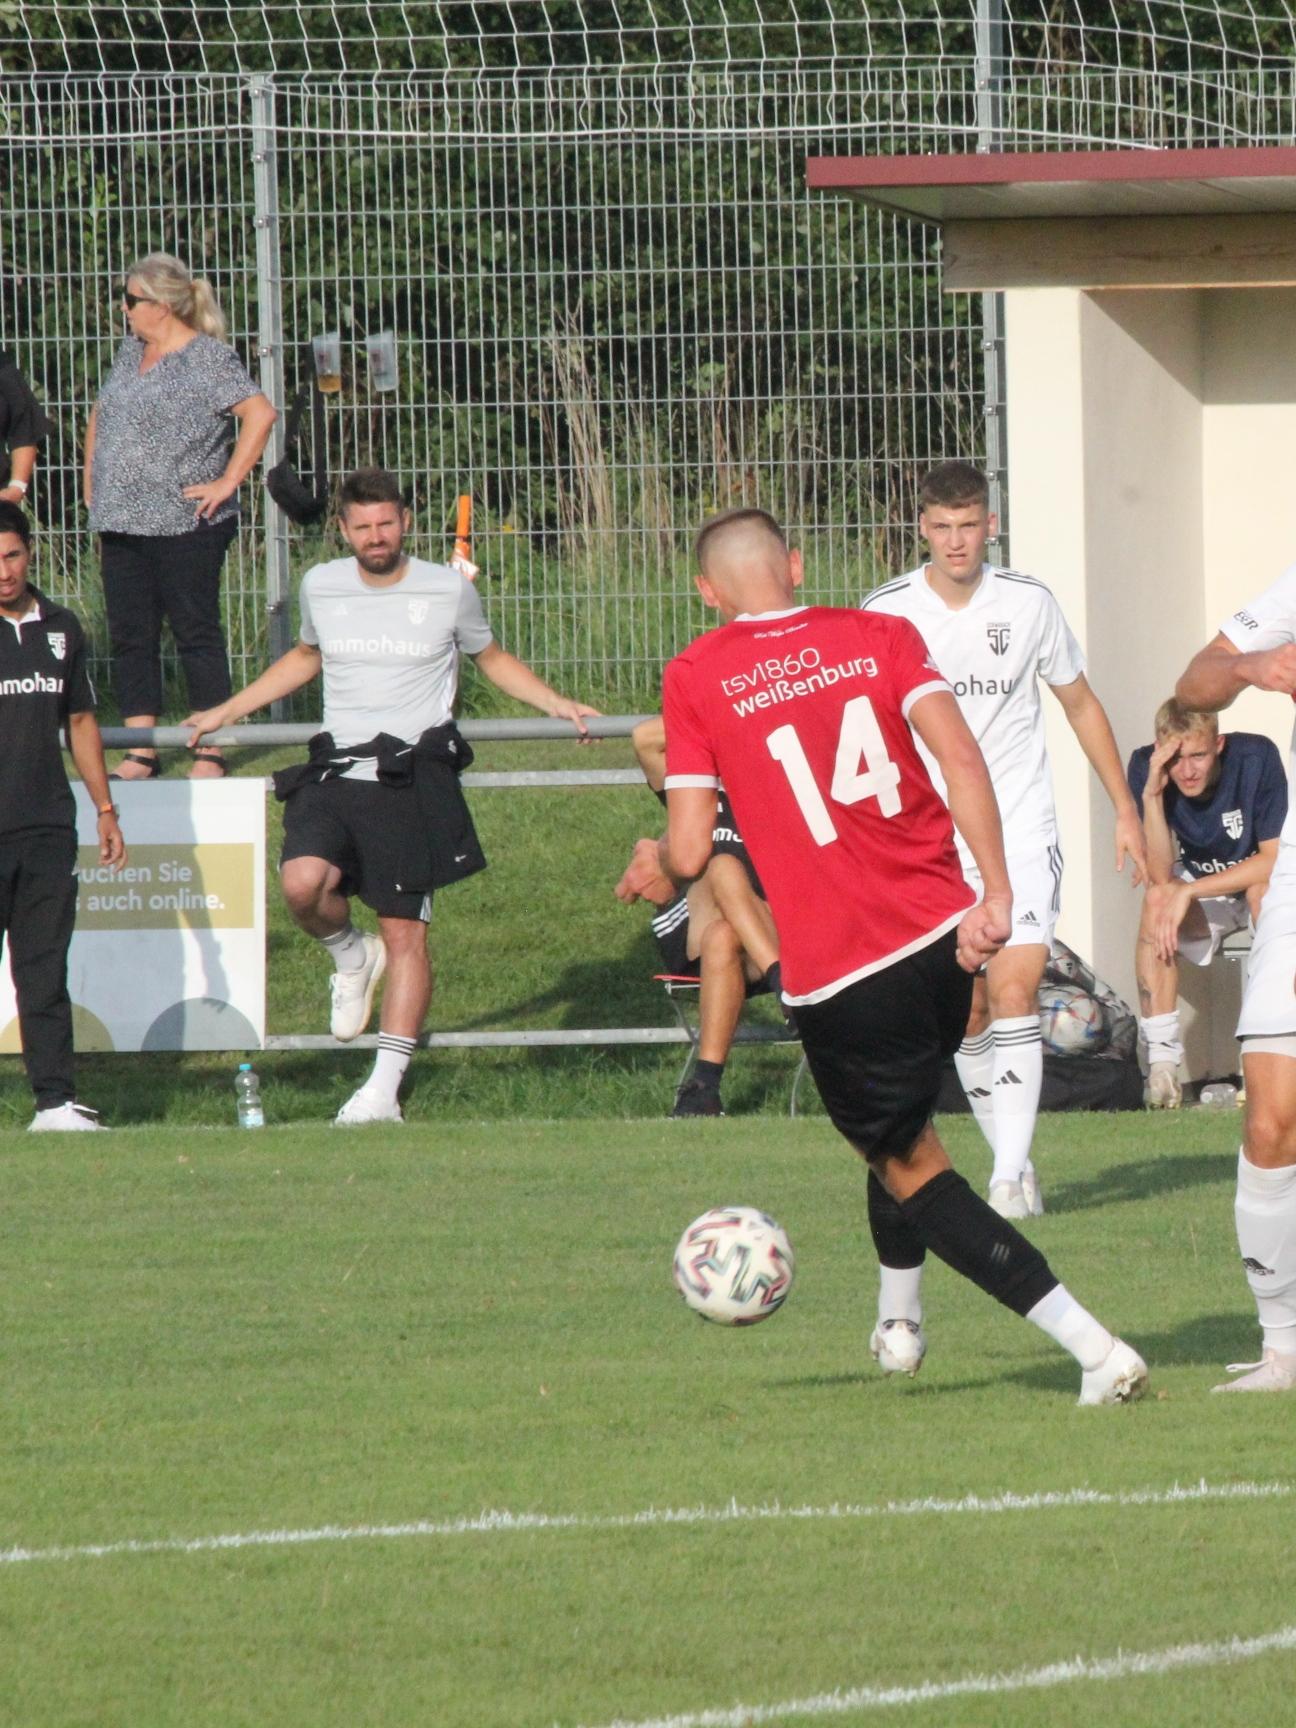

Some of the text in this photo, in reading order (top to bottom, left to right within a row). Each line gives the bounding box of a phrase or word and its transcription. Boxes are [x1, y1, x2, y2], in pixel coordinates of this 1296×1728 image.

[721, 647, 820, 697] tsv1860
[733, 656, 878, 718] weißenburg
[954, 674, 1014, 697] ohau
[766, 695, 903, 847] 14
[77, 861, 193, 884] uchen Sie
[87, 889, 143, 911] auch
[149, 888, 225, 911] online.
